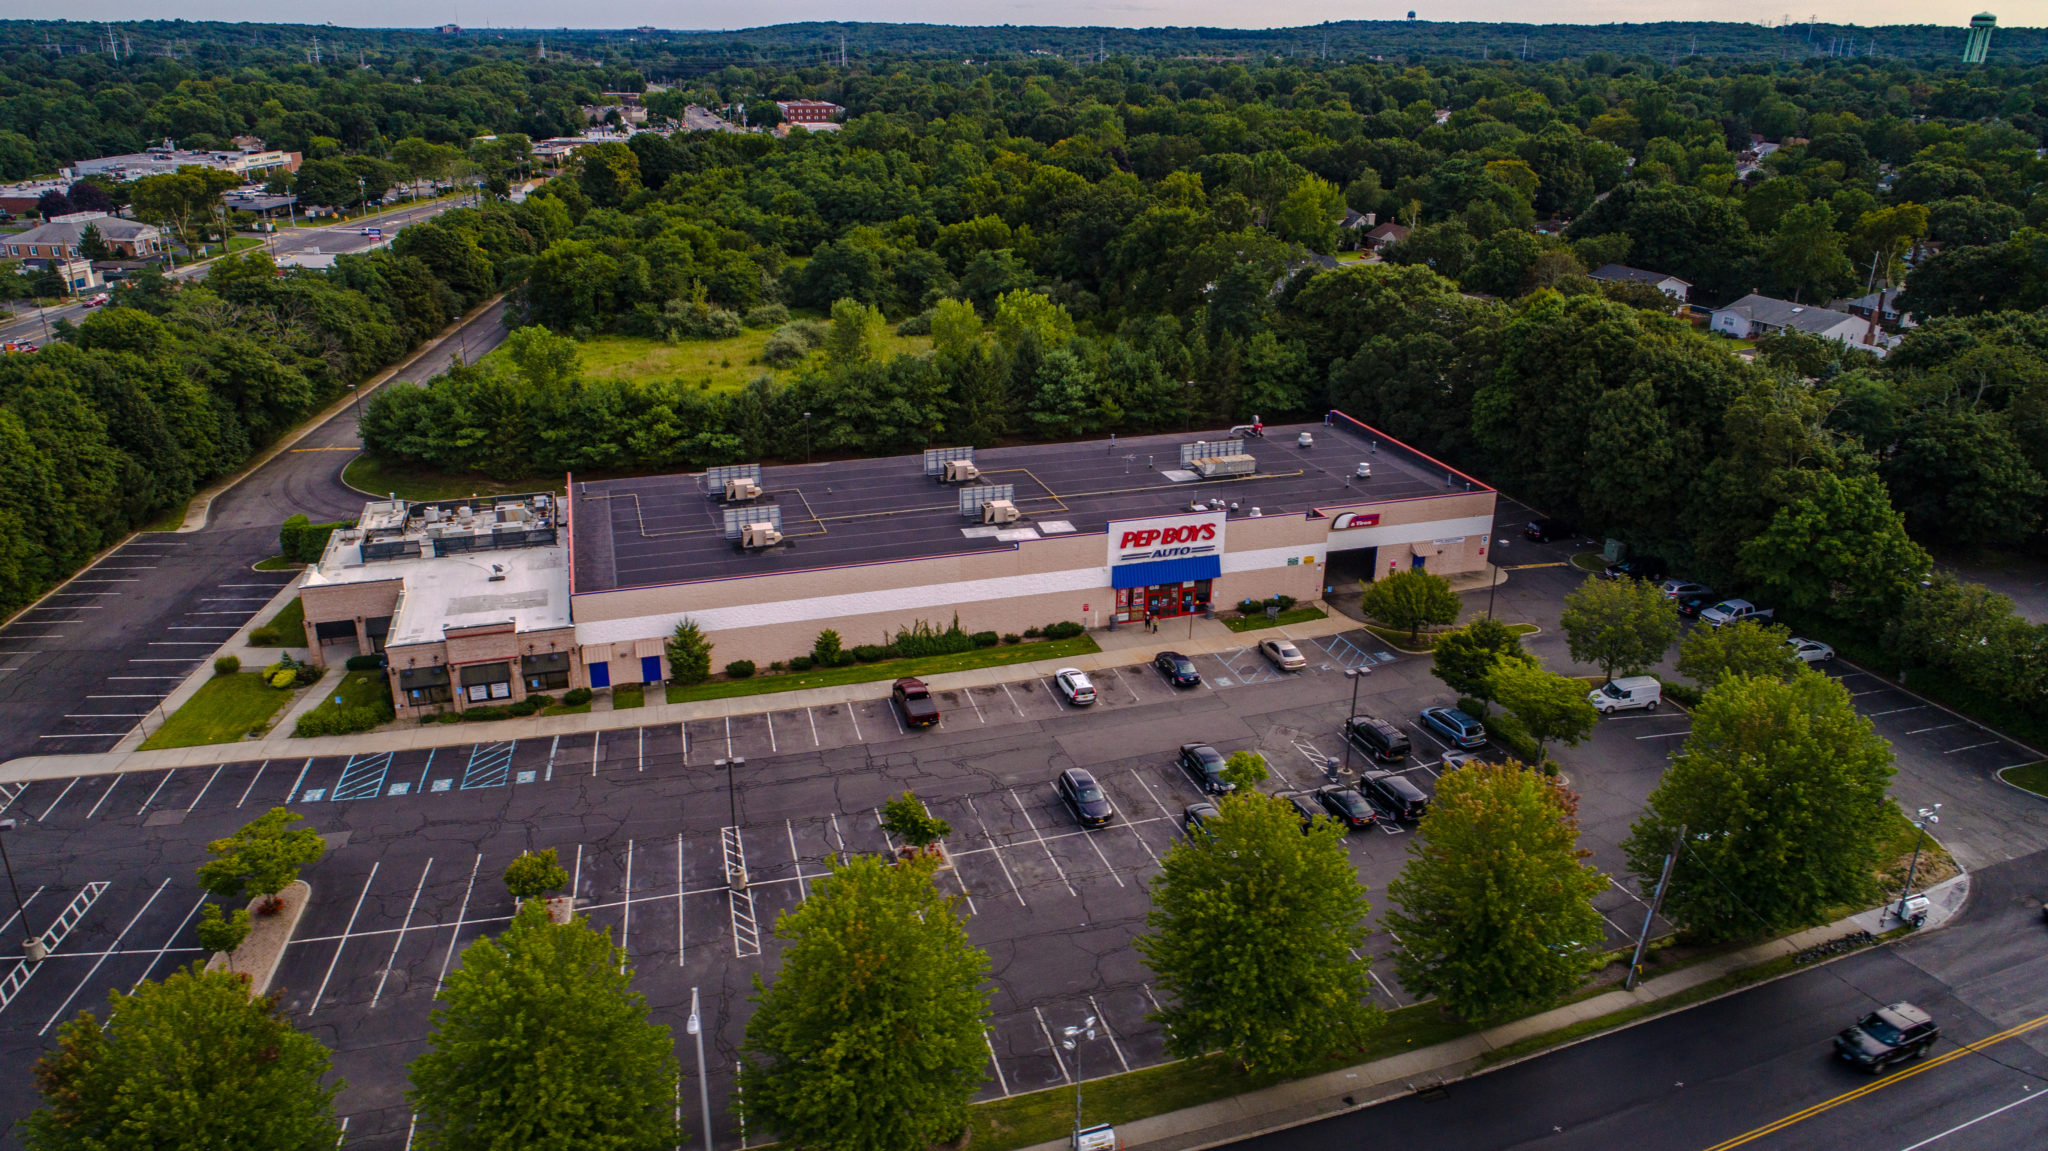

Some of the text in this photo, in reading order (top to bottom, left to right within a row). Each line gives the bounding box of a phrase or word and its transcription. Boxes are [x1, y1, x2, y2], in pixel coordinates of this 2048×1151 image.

[1120, 523, 1216, 549] PEP BOYS
[1151, 546, 1191, 559] AUTO
